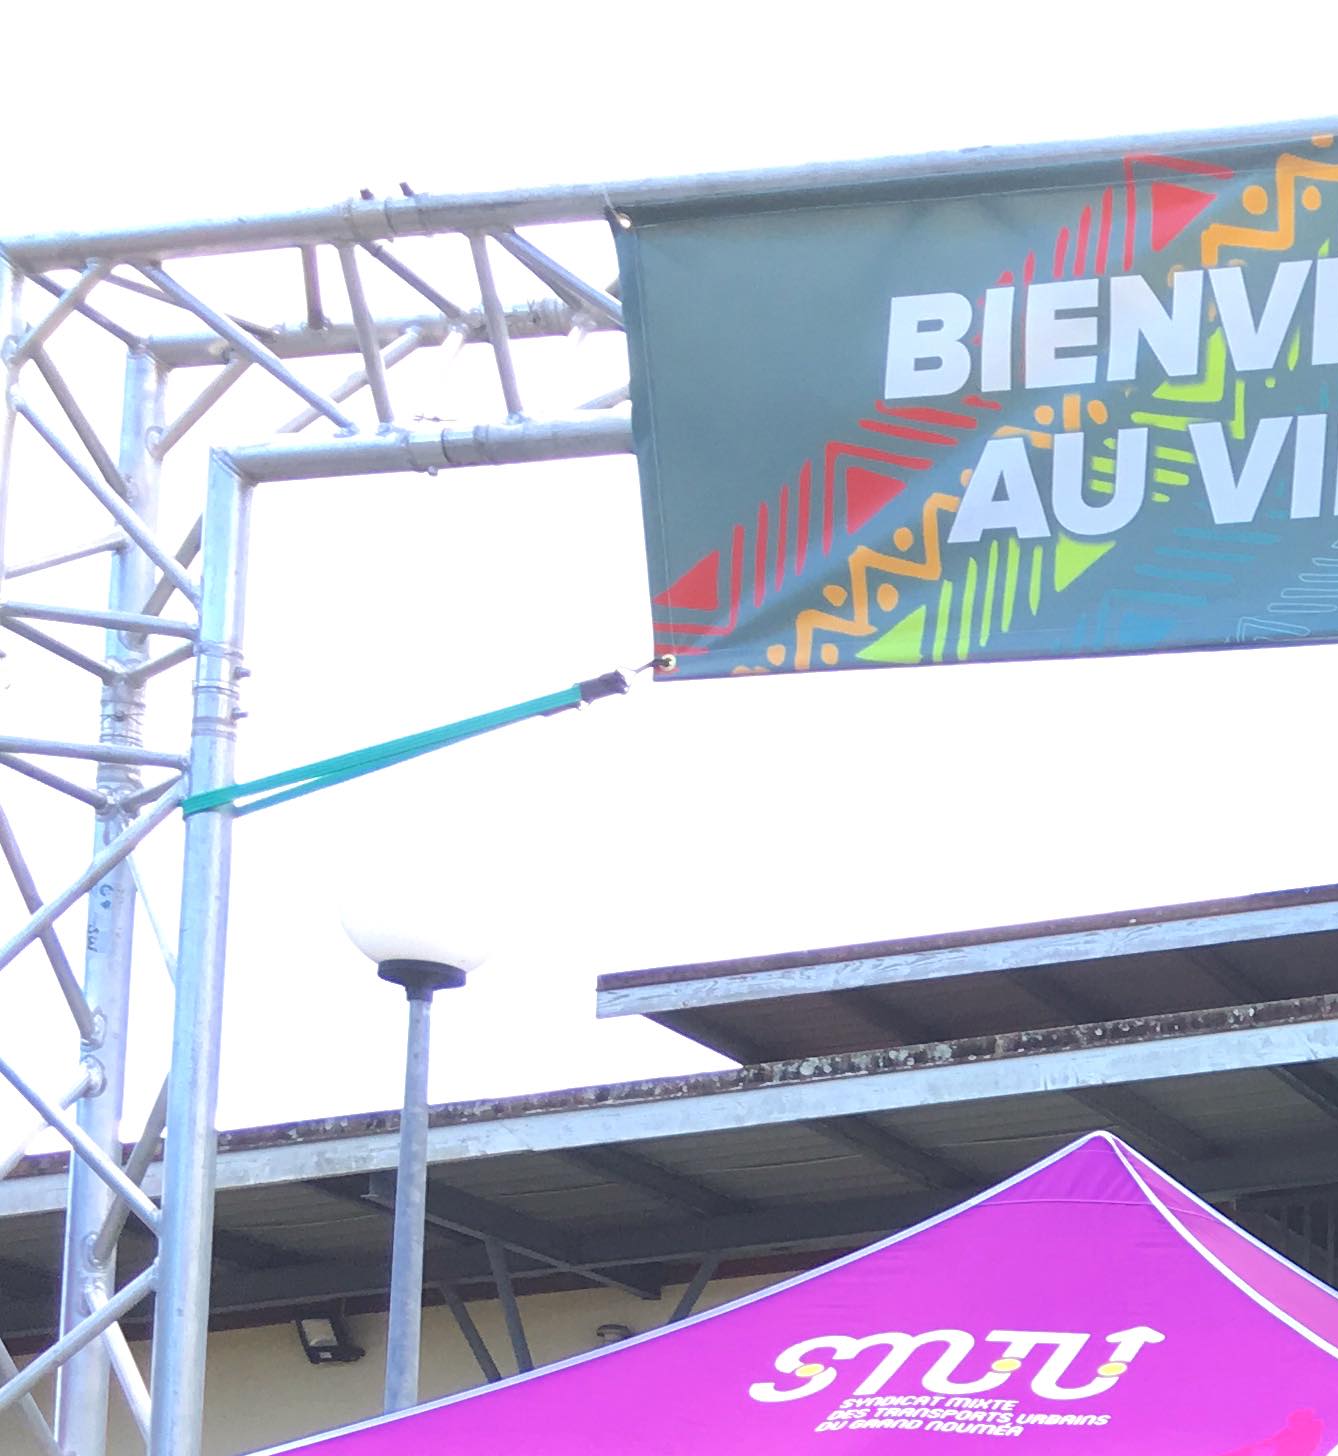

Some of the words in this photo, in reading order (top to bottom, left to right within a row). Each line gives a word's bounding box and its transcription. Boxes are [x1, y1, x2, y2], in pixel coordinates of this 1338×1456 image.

[948, 427, 1147, 545] AU
[840, 1395, 945, 1410] SYNDICAT
[947, 1397, 1019, 1411] MIXTE
[827, 1408, 870, 1421] DES
[873, 1407, 1014, 1425] TRANSPORTS
[1016, 1413, 1111, 1426] URBAINS
[814, 1420, 849, 1432] DU
[849, 1419, 923, 1431] GRAND
